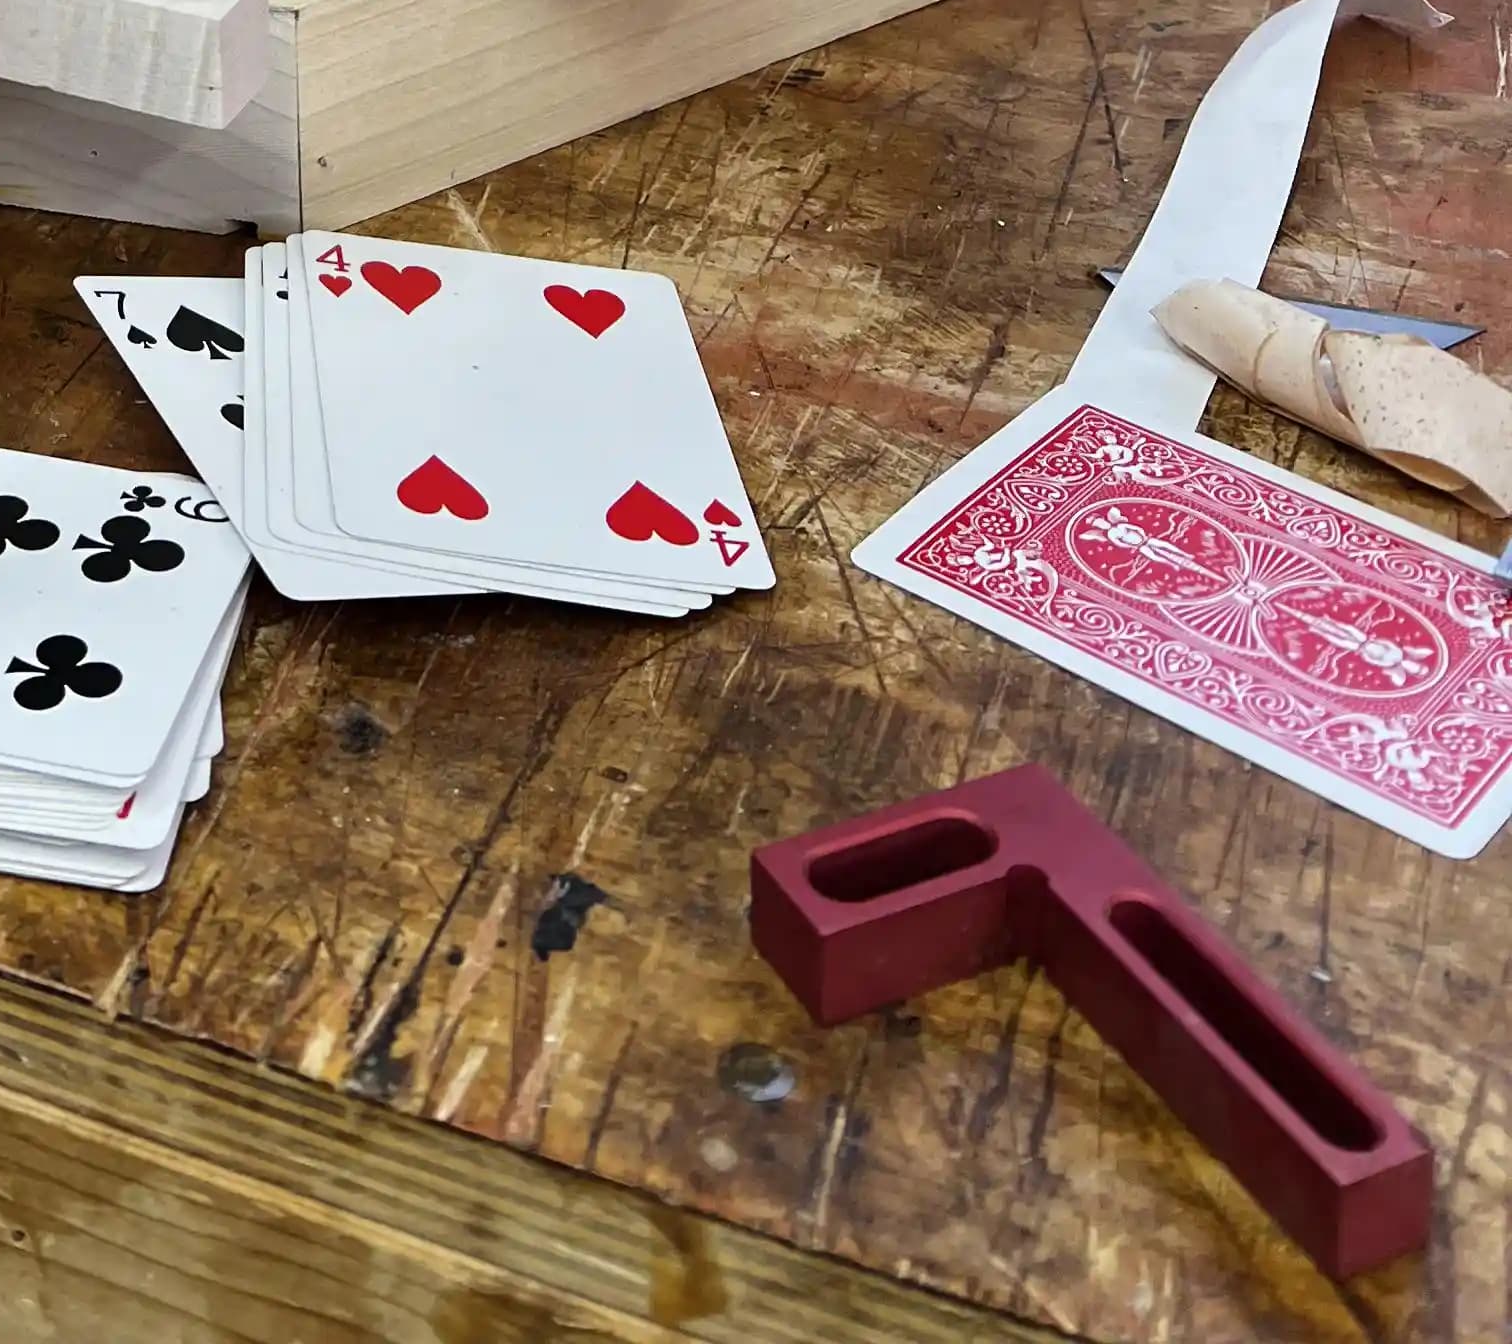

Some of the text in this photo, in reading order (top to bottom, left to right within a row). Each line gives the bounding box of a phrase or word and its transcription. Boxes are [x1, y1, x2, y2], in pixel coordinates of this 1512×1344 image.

[314, 243, 351, 274] 4
[93, 289, 129, 321] 7
[708, 529, 750, 568] 4
